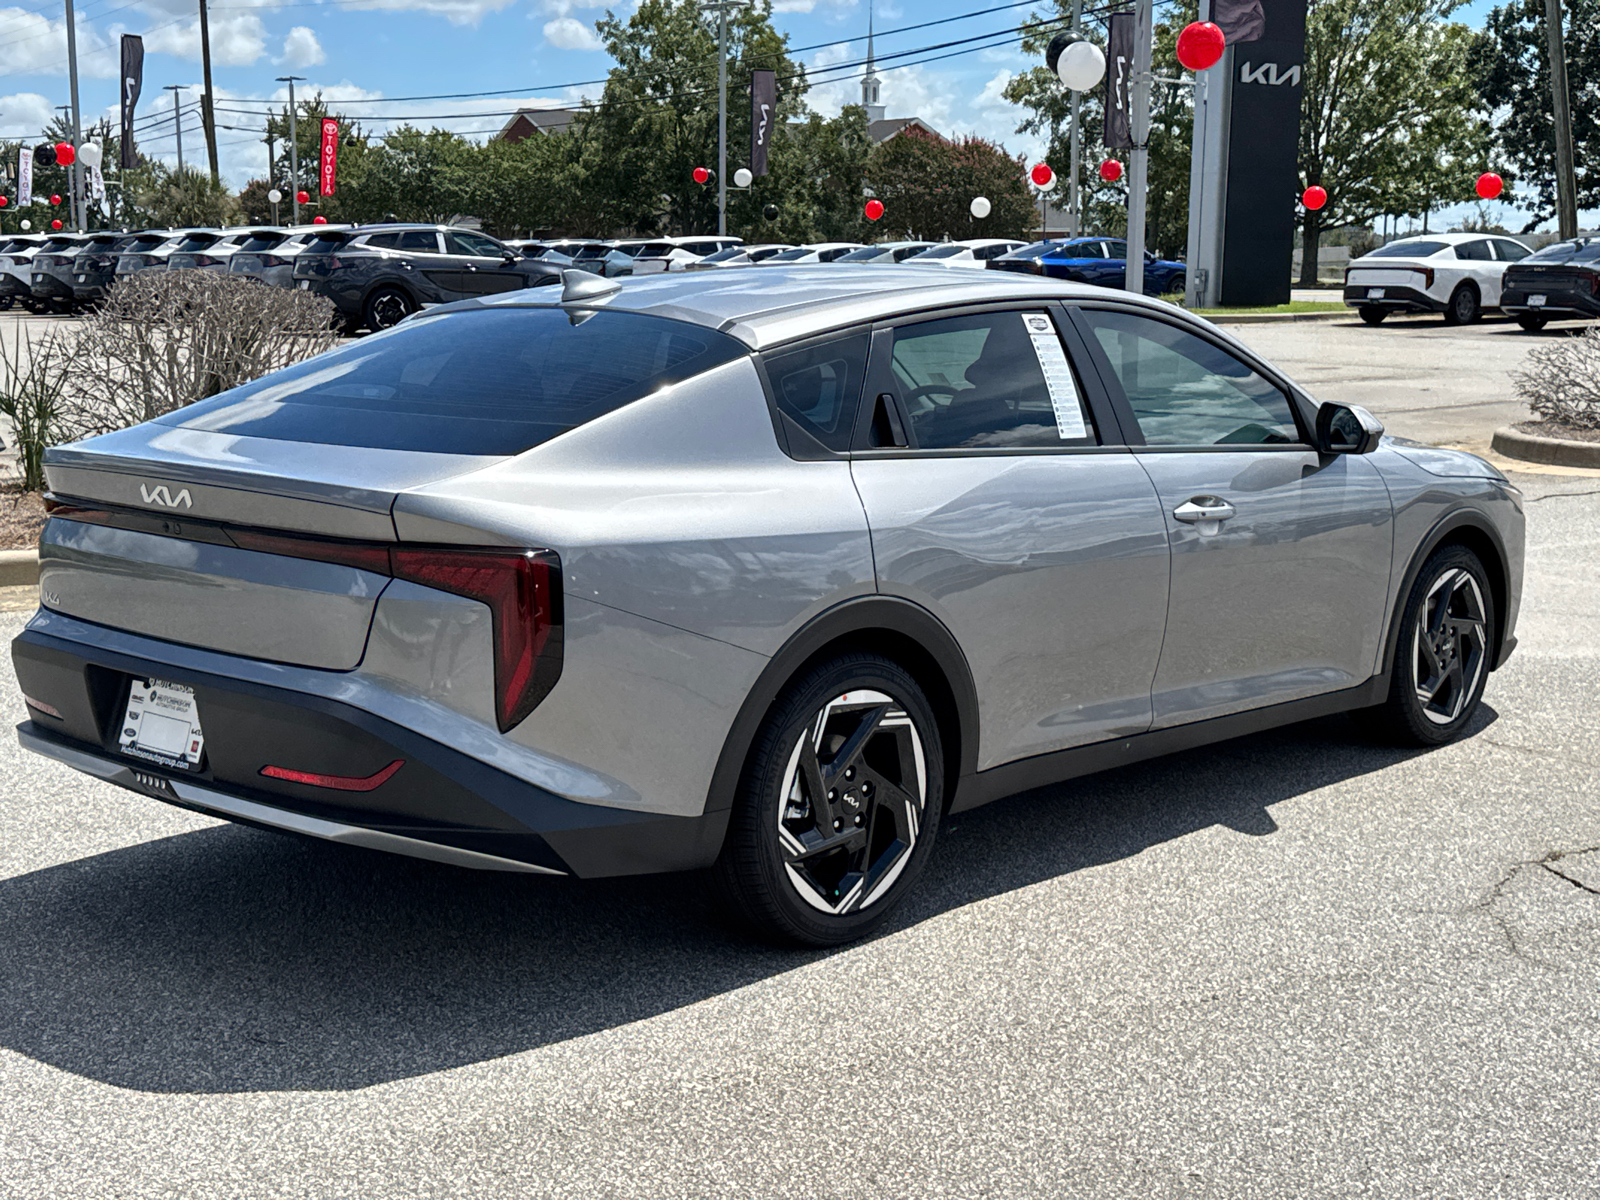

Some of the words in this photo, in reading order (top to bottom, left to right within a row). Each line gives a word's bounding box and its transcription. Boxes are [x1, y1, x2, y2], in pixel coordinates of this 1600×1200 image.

[1241, 61, 1300, 87] KIA
[324, 135, 333, 194] TOYOTA
[139, 483, 193, 509] KIA
[45, 591, 61, 605] K4
